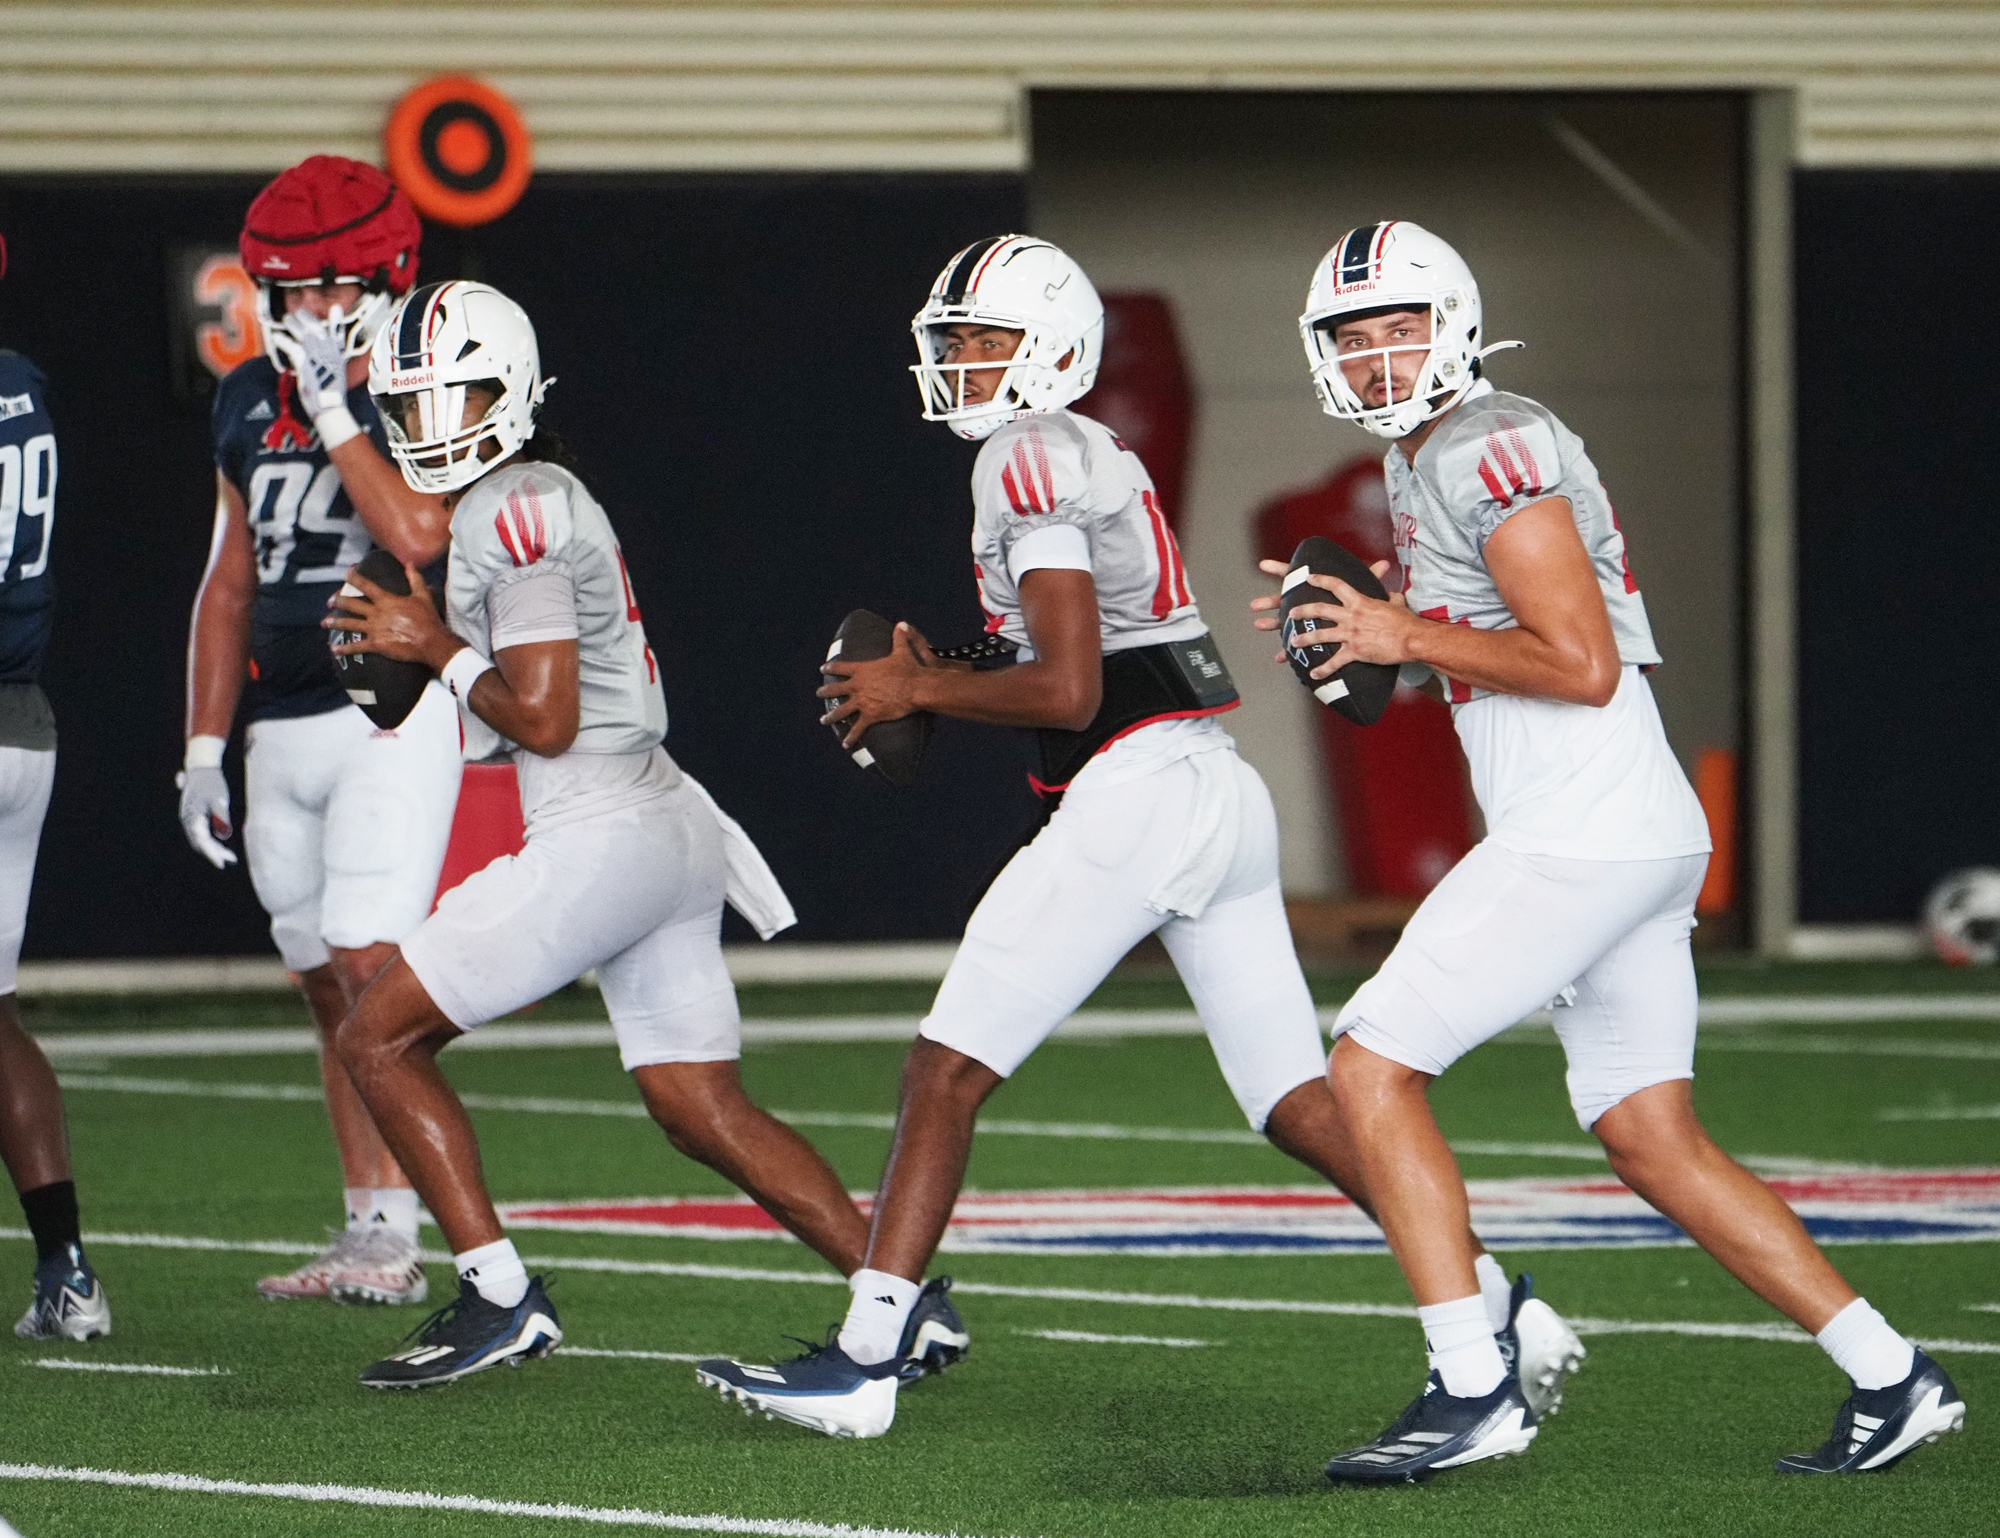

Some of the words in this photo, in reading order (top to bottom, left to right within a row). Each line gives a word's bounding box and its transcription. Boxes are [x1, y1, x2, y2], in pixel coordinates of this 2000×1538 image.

[1335, 281, 1376, 296] Riddell
[195, 257, 264, 374] 3
[391, 373, 434, 388] Riddell
